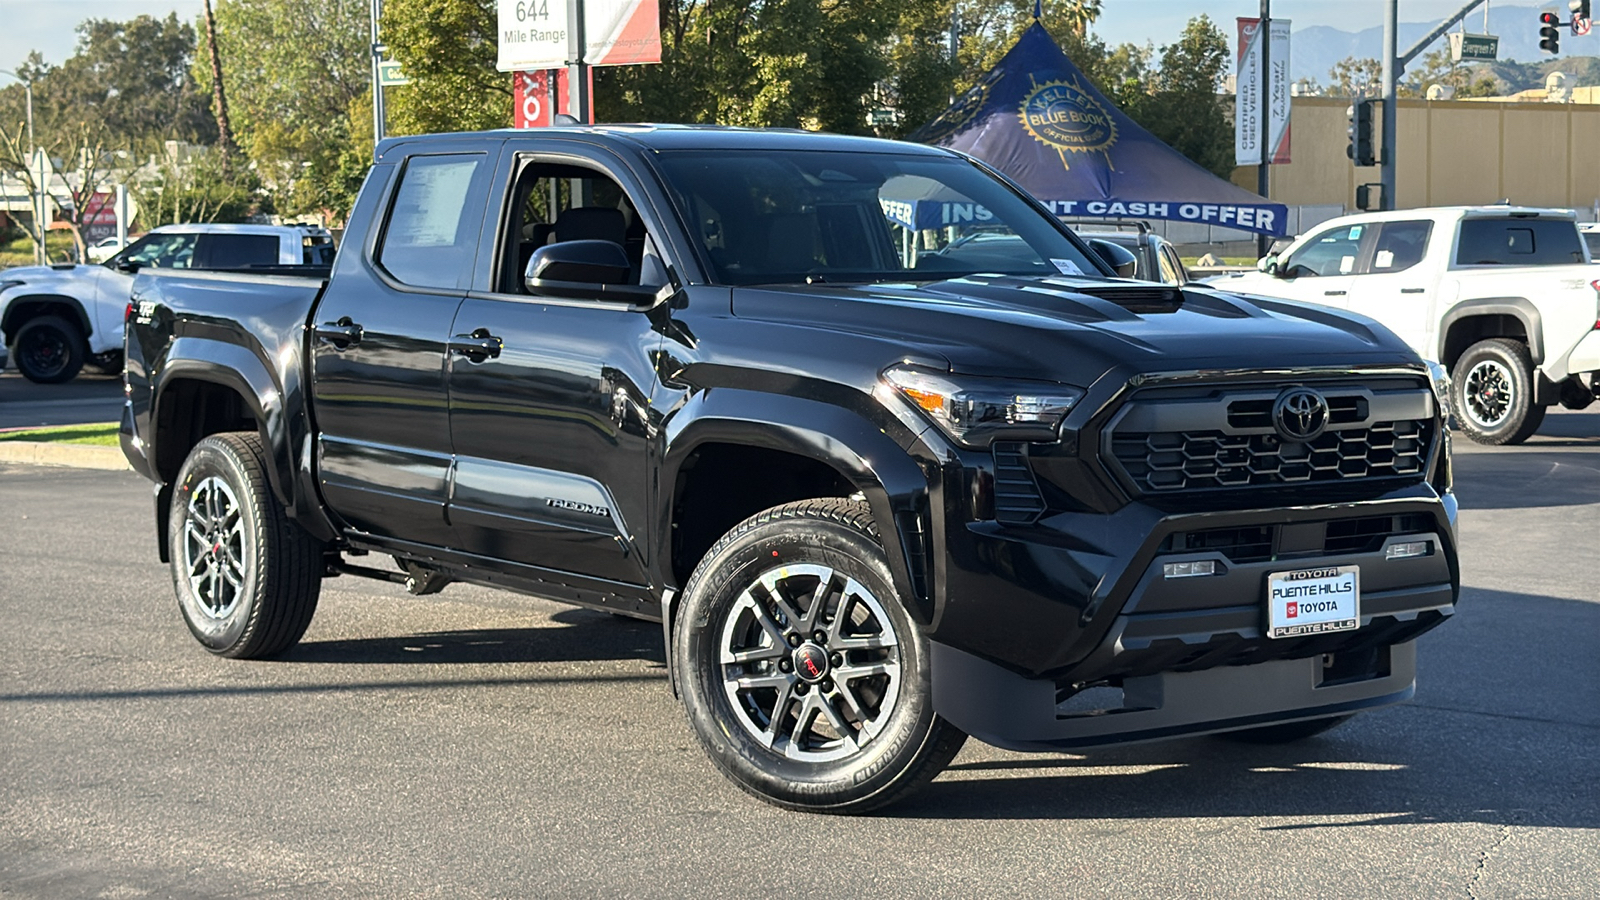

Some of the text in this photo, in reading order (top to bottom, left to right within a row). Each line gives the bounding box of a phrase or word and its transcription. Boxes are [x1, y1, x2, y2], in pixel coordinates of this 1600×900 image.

[516, 0, 549, 22] 644
[504, 28, 566, 43] Mile Range
[1032, 88, 1096, 110] KELLEY
[1029, 110, 1107, 127] BLUE BOOK
[1273, 109, 1280, 118] 7
[1043, 128, 1085, 143] OFFICIAL
[1086, 201, 1169, 217] CASH
[1178, 204, 1276, 231] OFFER
[545, 497, 609, 516] TACOMA
[1290, 568, 1337, 580] TOYOTA
[1272, 582, 1352, 599] PUENTE HILLS
[1300, 601, 1338, 613] TOYOTA
[1275, 620, 1355, 636] PUENTE HILLS
